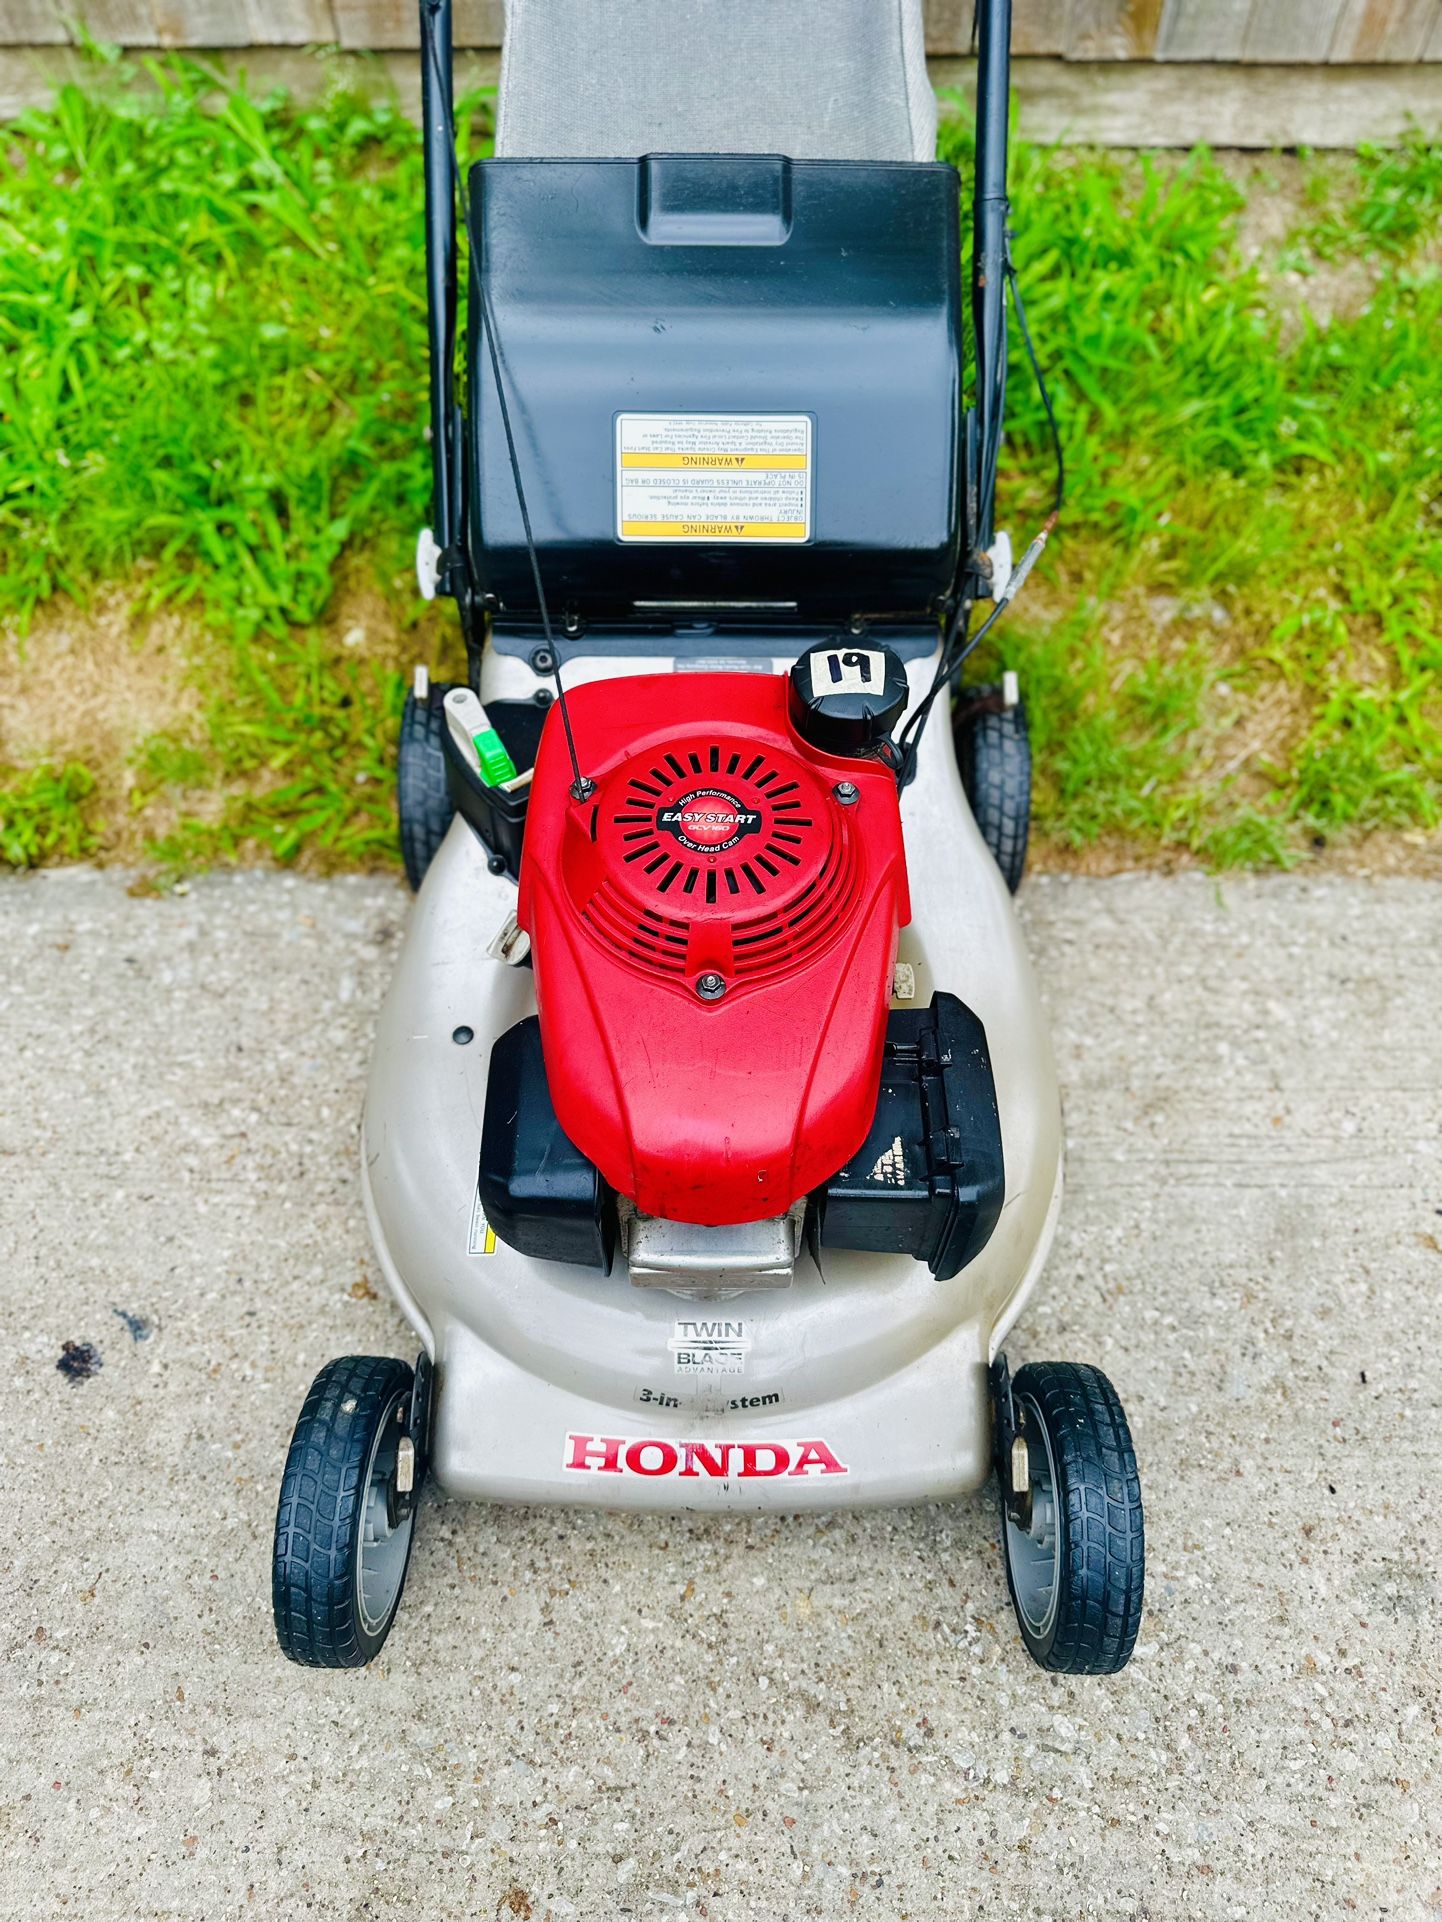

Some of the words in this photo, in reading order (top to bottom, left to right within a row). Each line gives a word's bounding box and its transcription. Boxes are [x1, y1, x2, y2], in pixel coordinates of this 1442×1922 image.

[682, 457, 732, 465] WARNING
[682, 525, 732, 533] WARNING
[678, 794, 696, 807] High
[696, 790, 742, 808] Performance
[662, 812, 704, 822] EASY
[705, 813, 756, 824] START
[678, 835, 697, 849] Over
[722, 836, 740, 849] Cam
[678, 1322, 742, 1338] TWIN
[566, 1434, 848, 1478] HONDA
